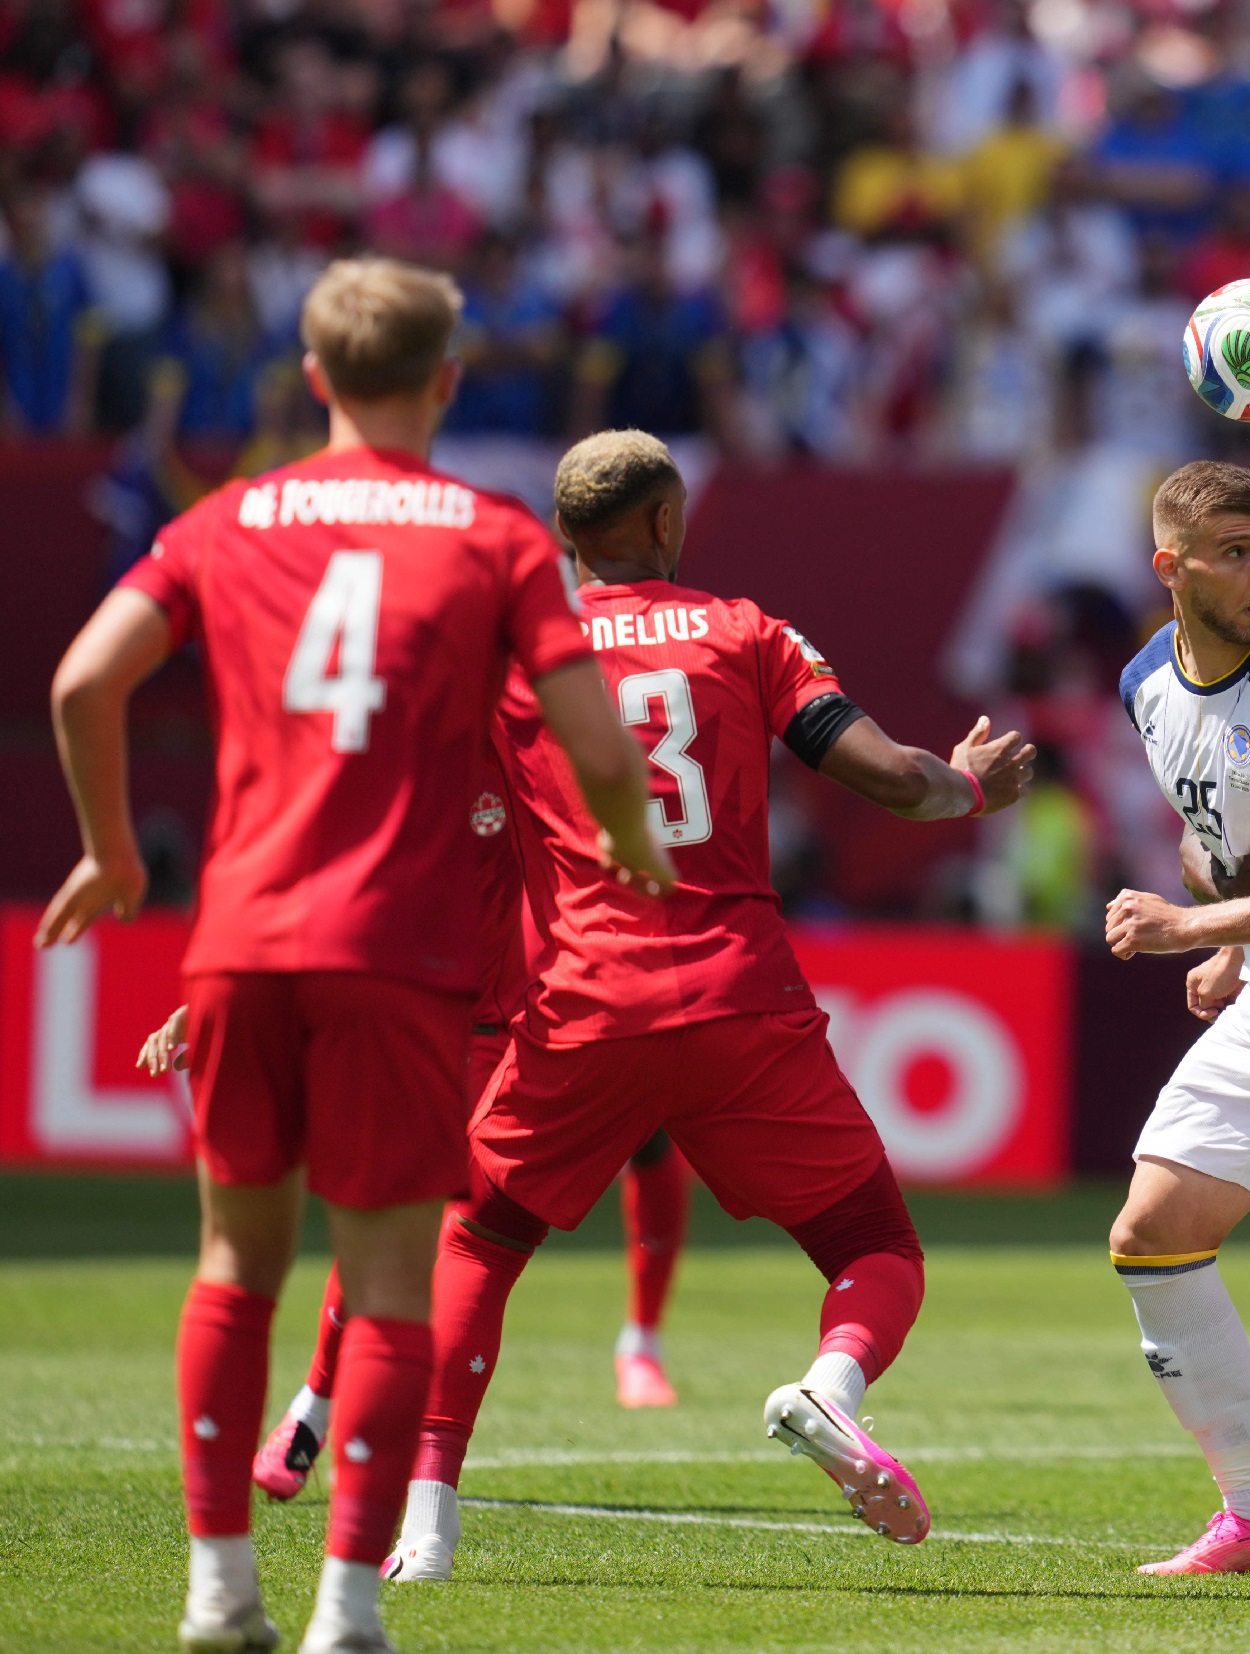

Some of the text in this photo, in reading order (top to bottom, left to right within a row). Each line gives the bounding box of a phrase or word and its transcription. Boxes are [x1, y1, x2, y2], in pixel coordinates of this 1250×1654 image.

[281, 548, 388, 754] 4
[582, 608, 710, 651] NELIUS
[602, 668, 713, 848] 3
[1175, 777, 1223, 841] 25
